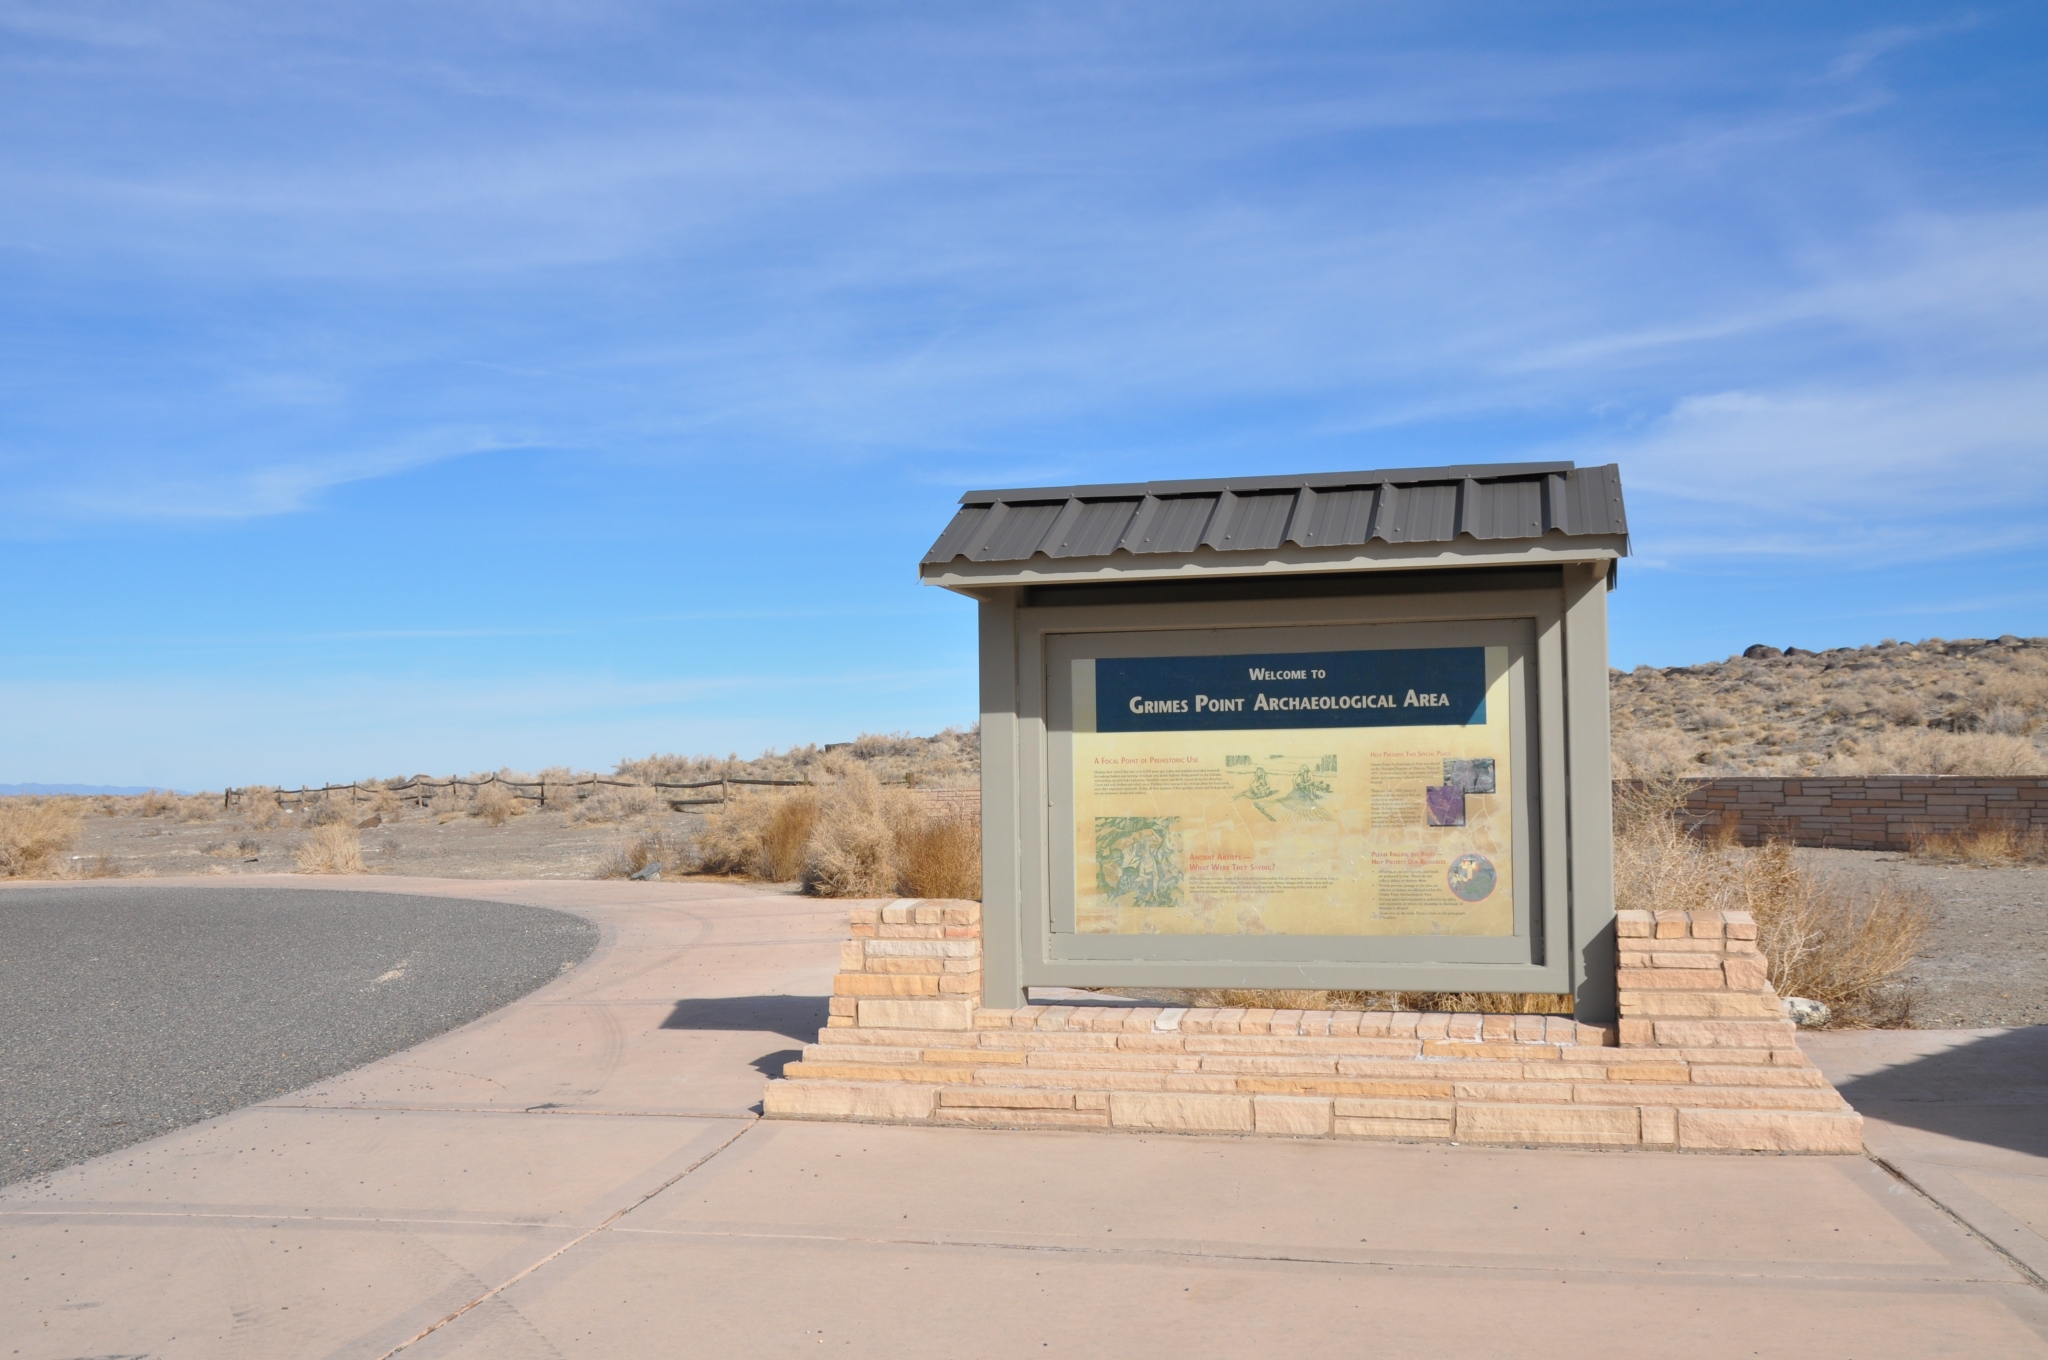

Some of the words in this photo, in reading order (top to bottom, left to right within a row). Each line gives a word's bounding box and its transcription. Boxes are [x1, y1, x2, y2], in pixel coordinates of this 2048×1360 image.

[1249, 668, 1307, 681] WELCOME
[1311, 669, 1326, 680] TO
[1129, 696, 1188, 714] GRIMES
[1195, 694, 1245, 712] POINT
[1253, 693, 1397, 711] ARCHAEOLOGICAL
[1403, 689, 1450, 708] AREA
[1094, 757, 1100, 765] A
[1149, 756, 1185, 764] PREHISTORIC
[1231, 863, 1248, 871] THEY
[1250, 863, 1276, 871] SAYING?
